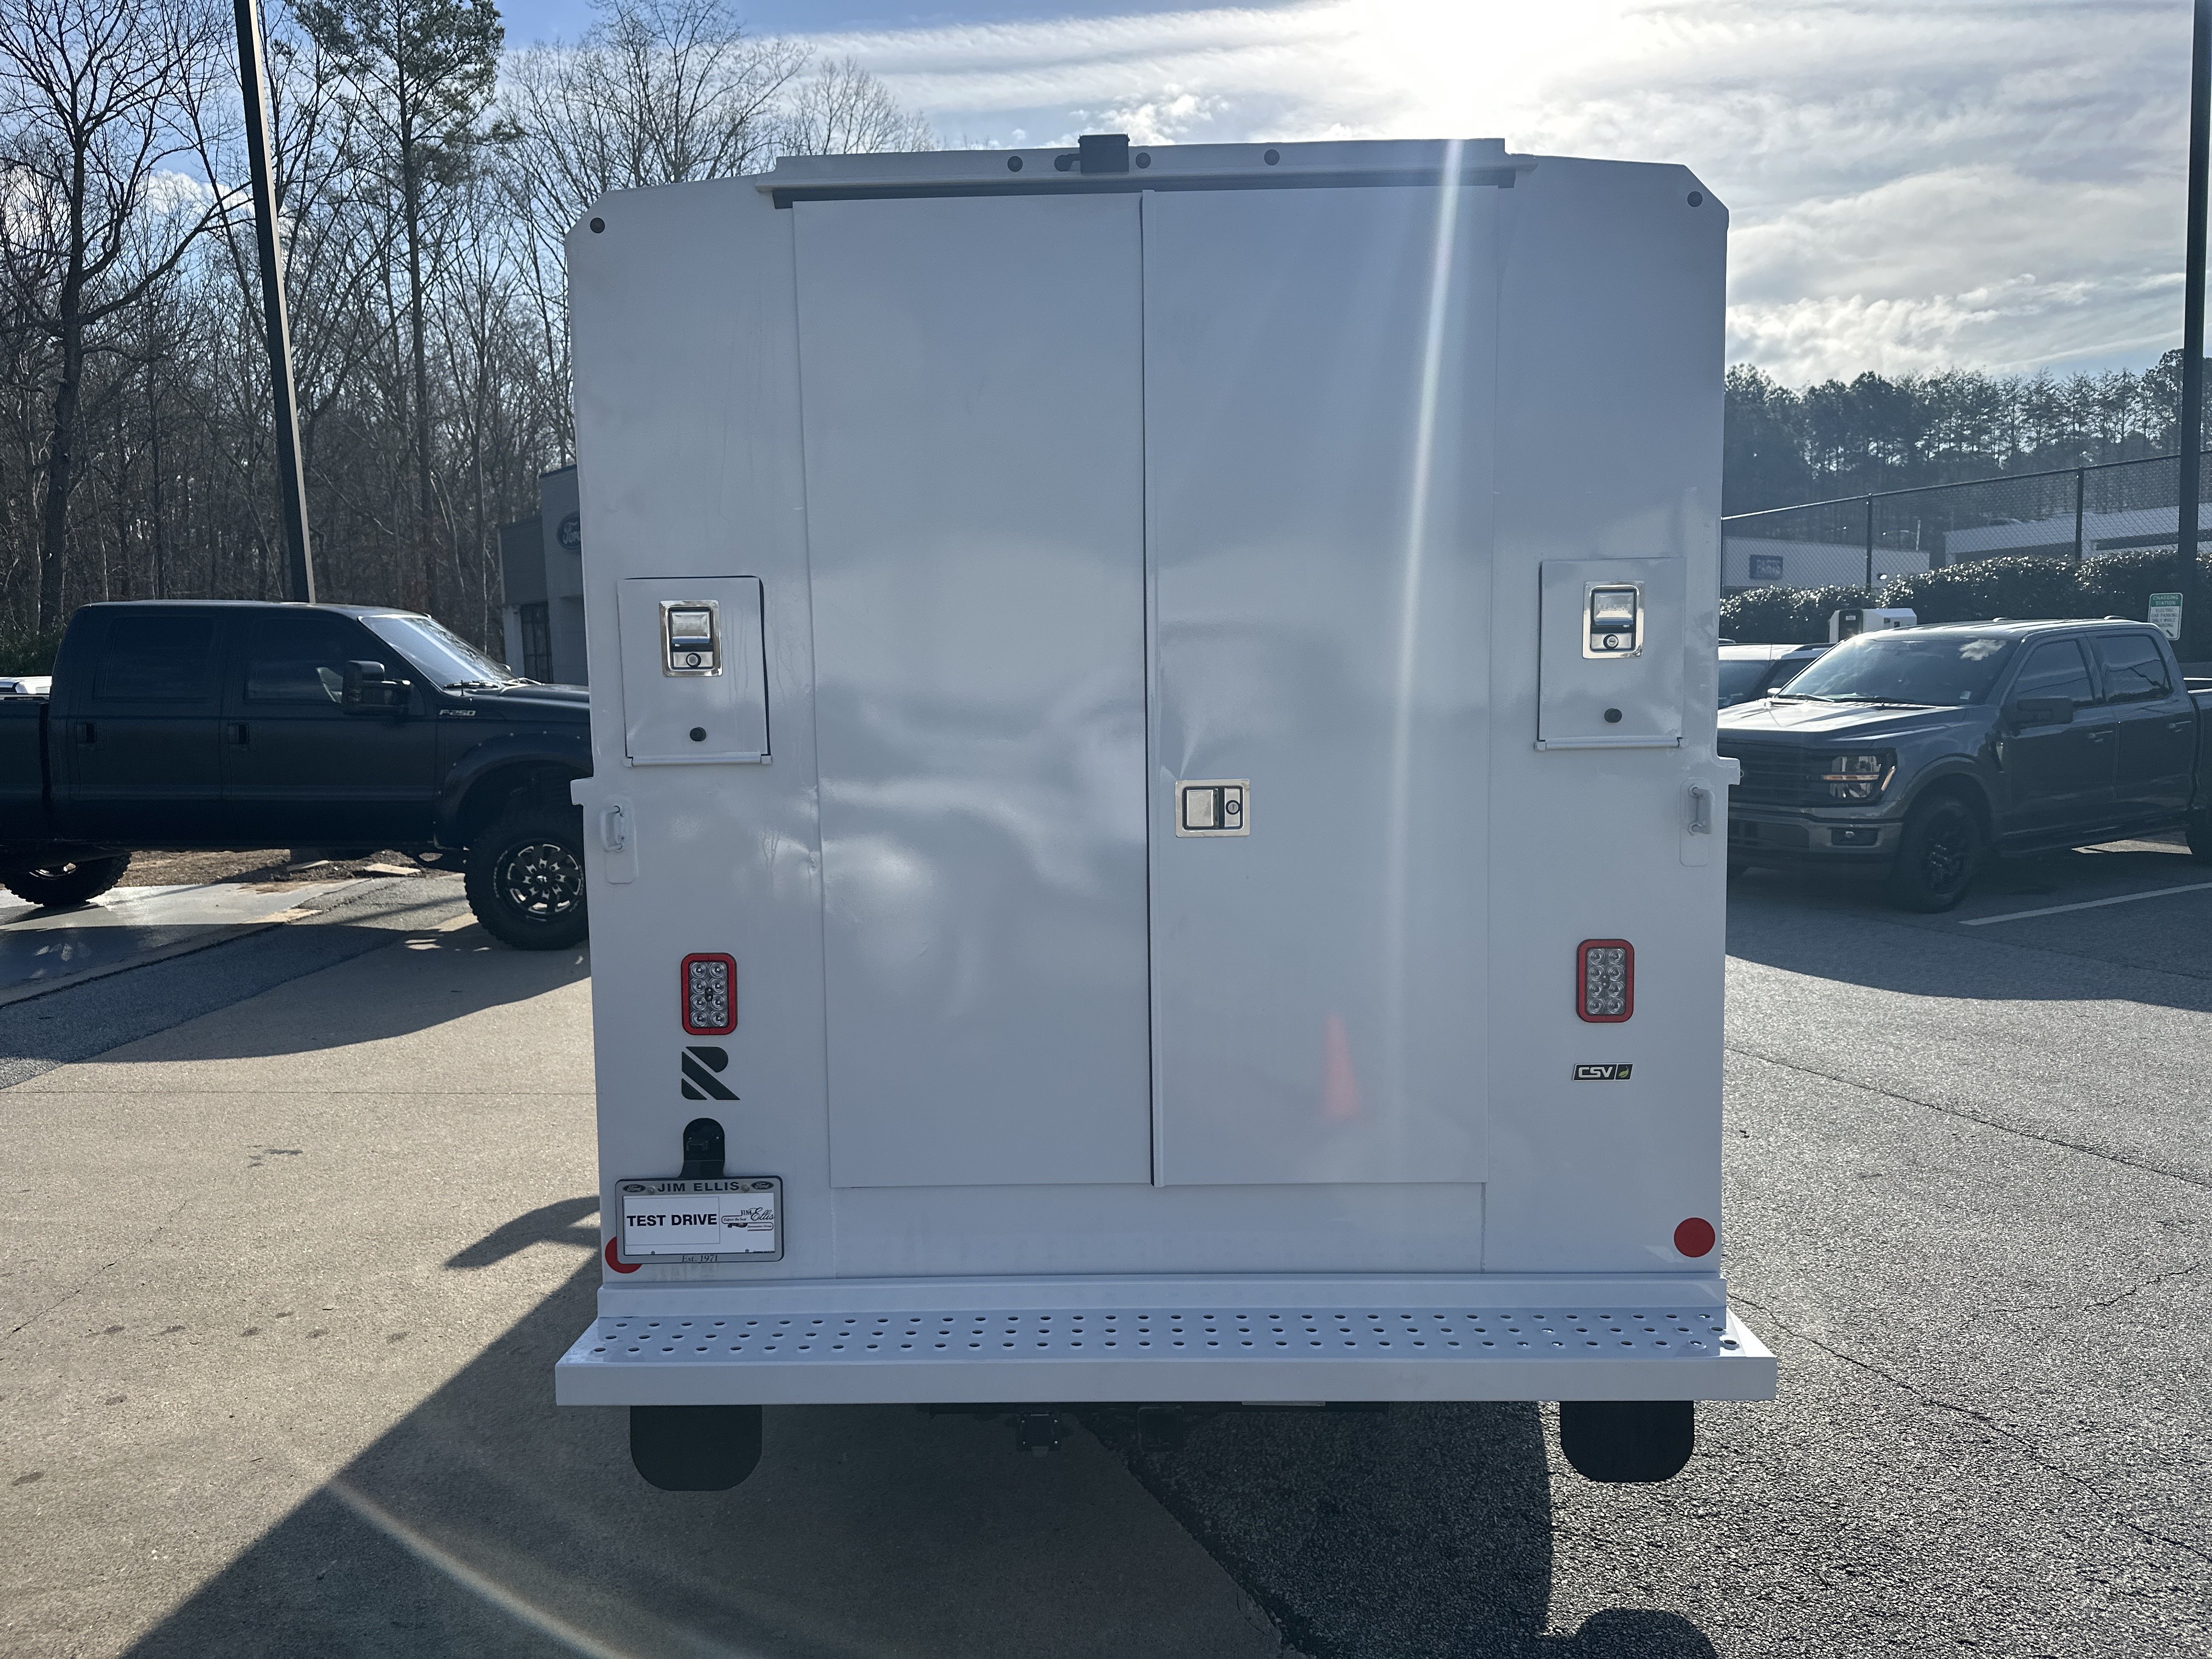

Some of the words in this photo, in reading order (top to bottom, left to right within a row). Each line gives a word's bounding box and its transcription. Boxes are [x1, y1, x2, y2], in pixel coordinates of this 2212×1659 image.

[1578, 1066, 1613, 1078] CSV
[657, 1183, 686, 1192] JIM
[693, 1181, 740, 1192] ELLIS
[627, 1215, 666, 1227] TEST
[671, 1214, 717, 1226] DRIVE
[748, 1207, 774, 1222] Ellis
[701, 1254, 718, 1262] 1971
